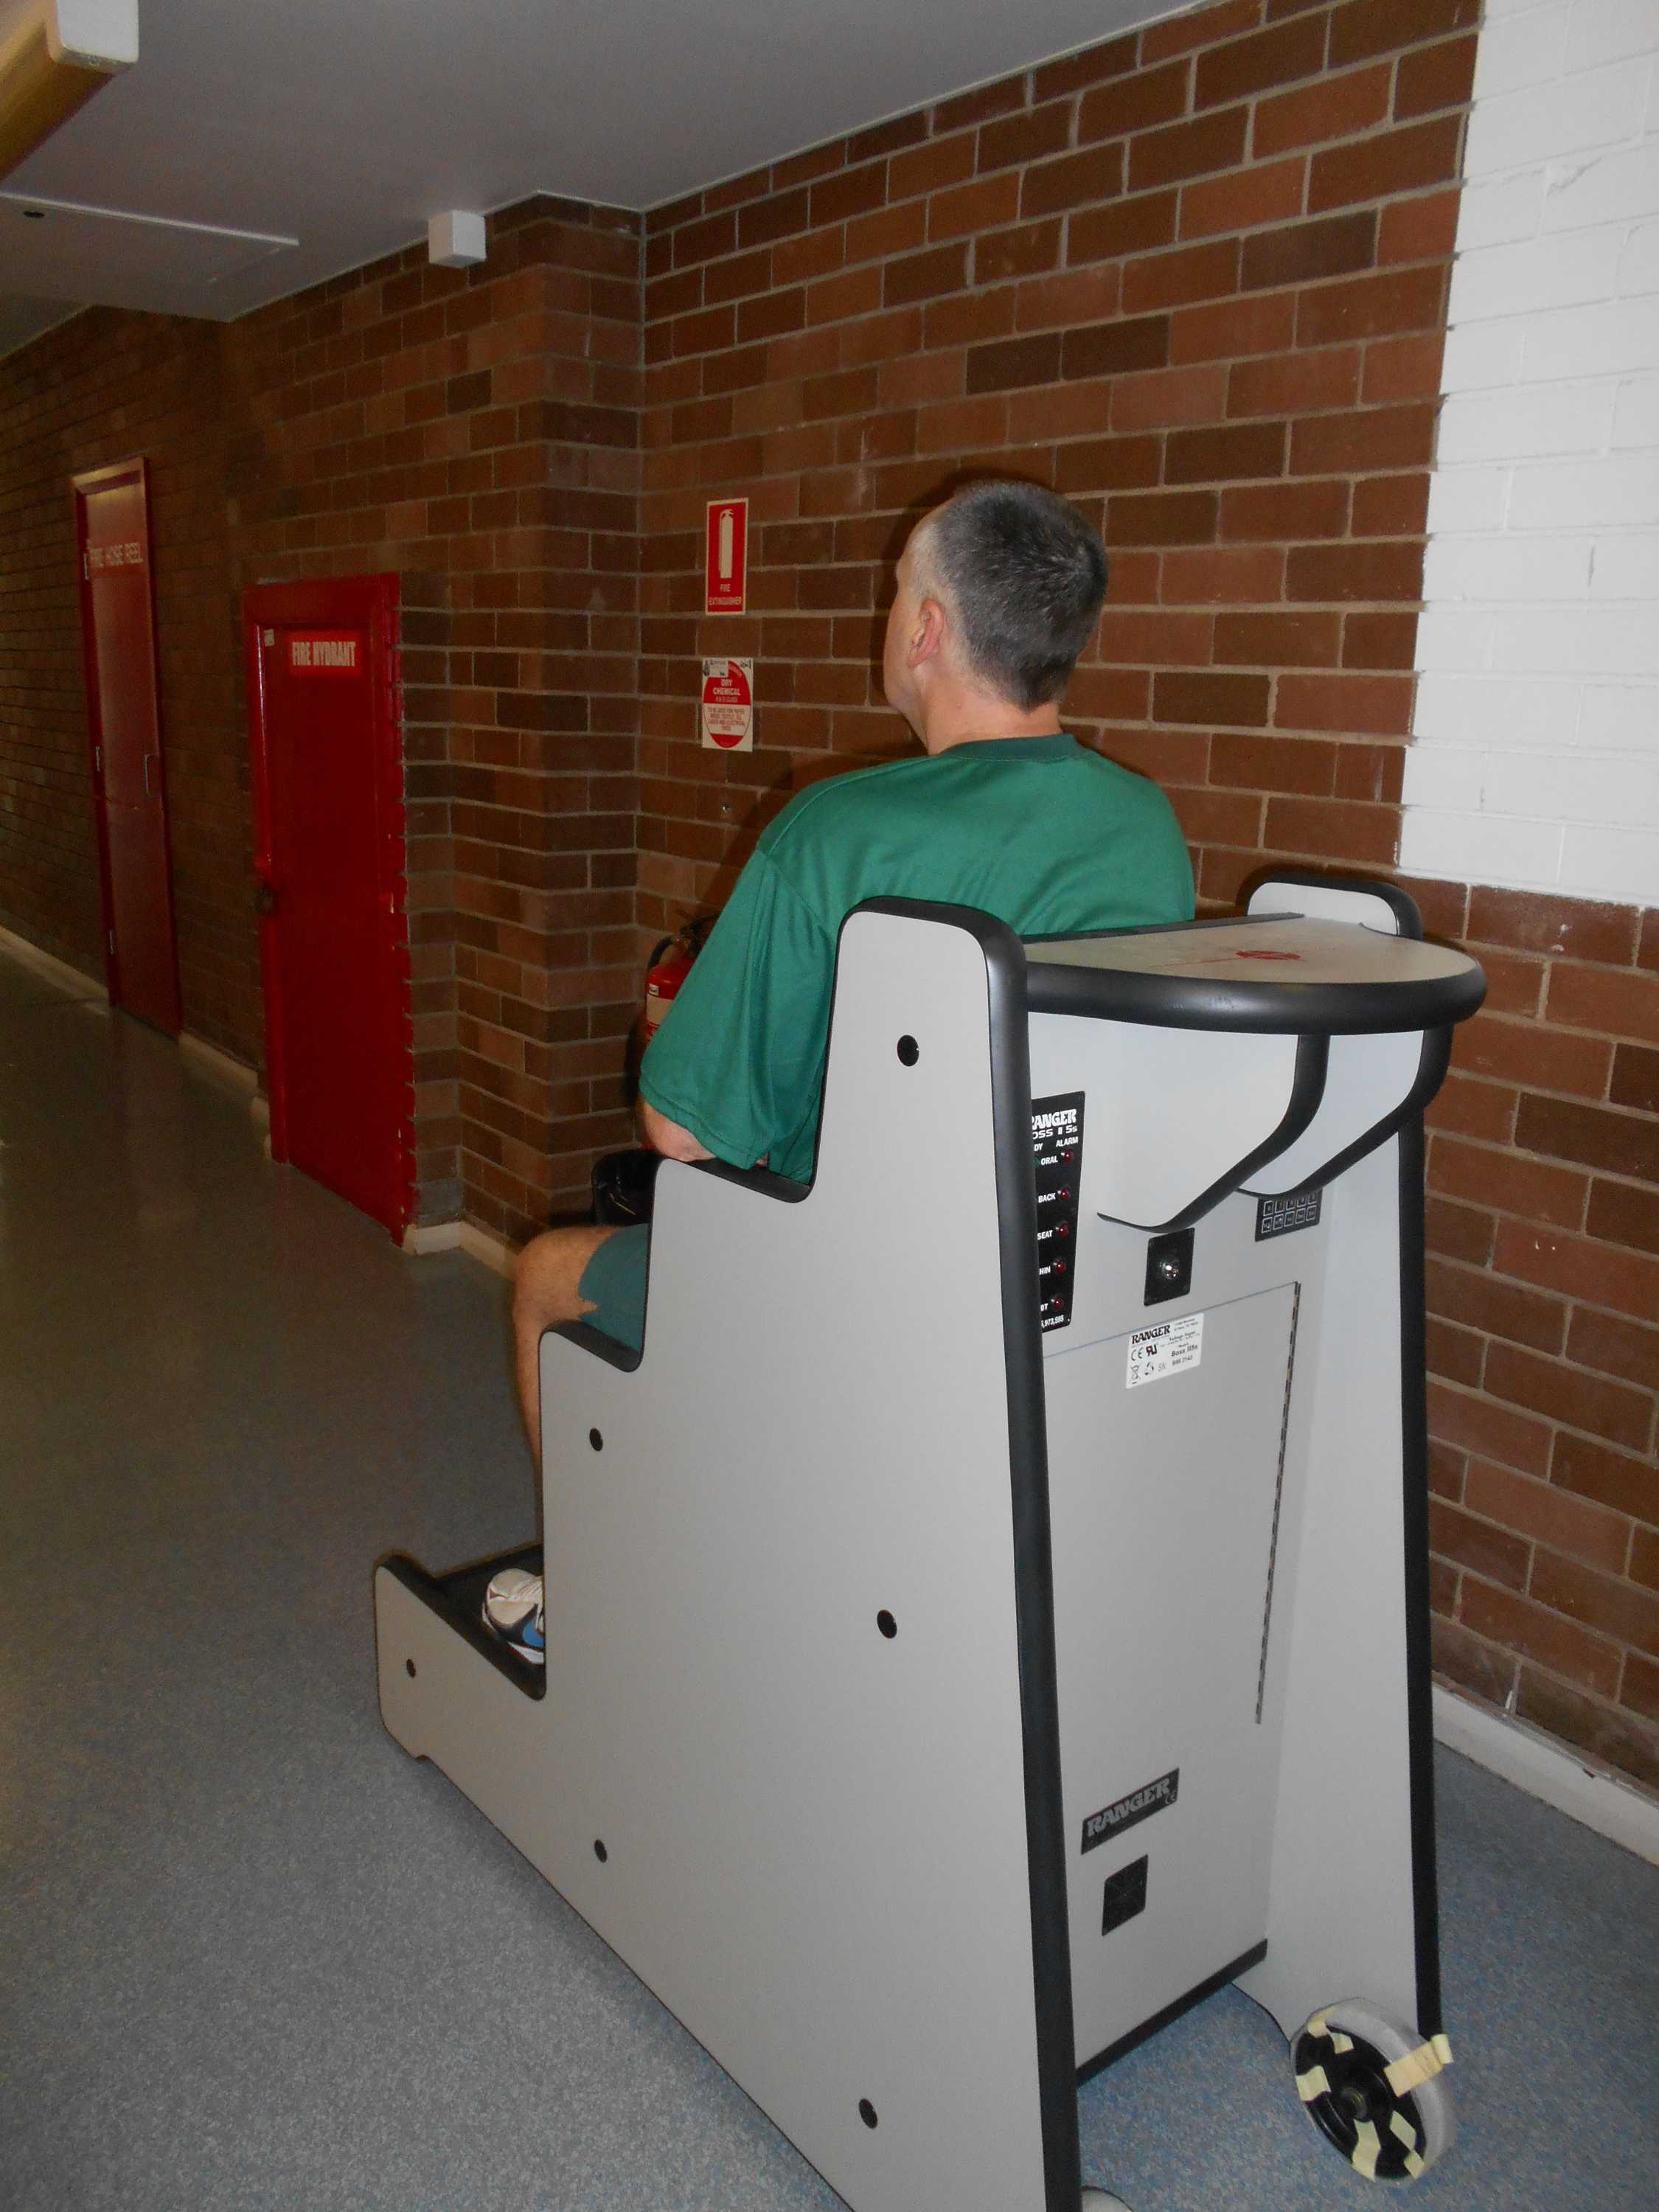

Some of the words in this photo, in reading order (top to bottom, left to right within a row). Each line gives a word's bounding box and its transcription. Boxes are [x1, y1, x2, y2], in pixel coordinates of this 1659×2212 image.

[292, 641, 310, 666] FIRE
[313, 641, 355, 667] HYDRANT
[712, 686, 742, 696] CHEMICAL
[1056, 1136, 1079, 1147] ALARM
[1040, 1155, 1058, 1166] ORAL
[1037, 1192, 1056, 1203] BACK
[1037, 1229, 1053, 1240] SEAT
[1132, 1325, 1170, 1344] RANGER
[1087, 1778, 1169, 1837] RANGER
